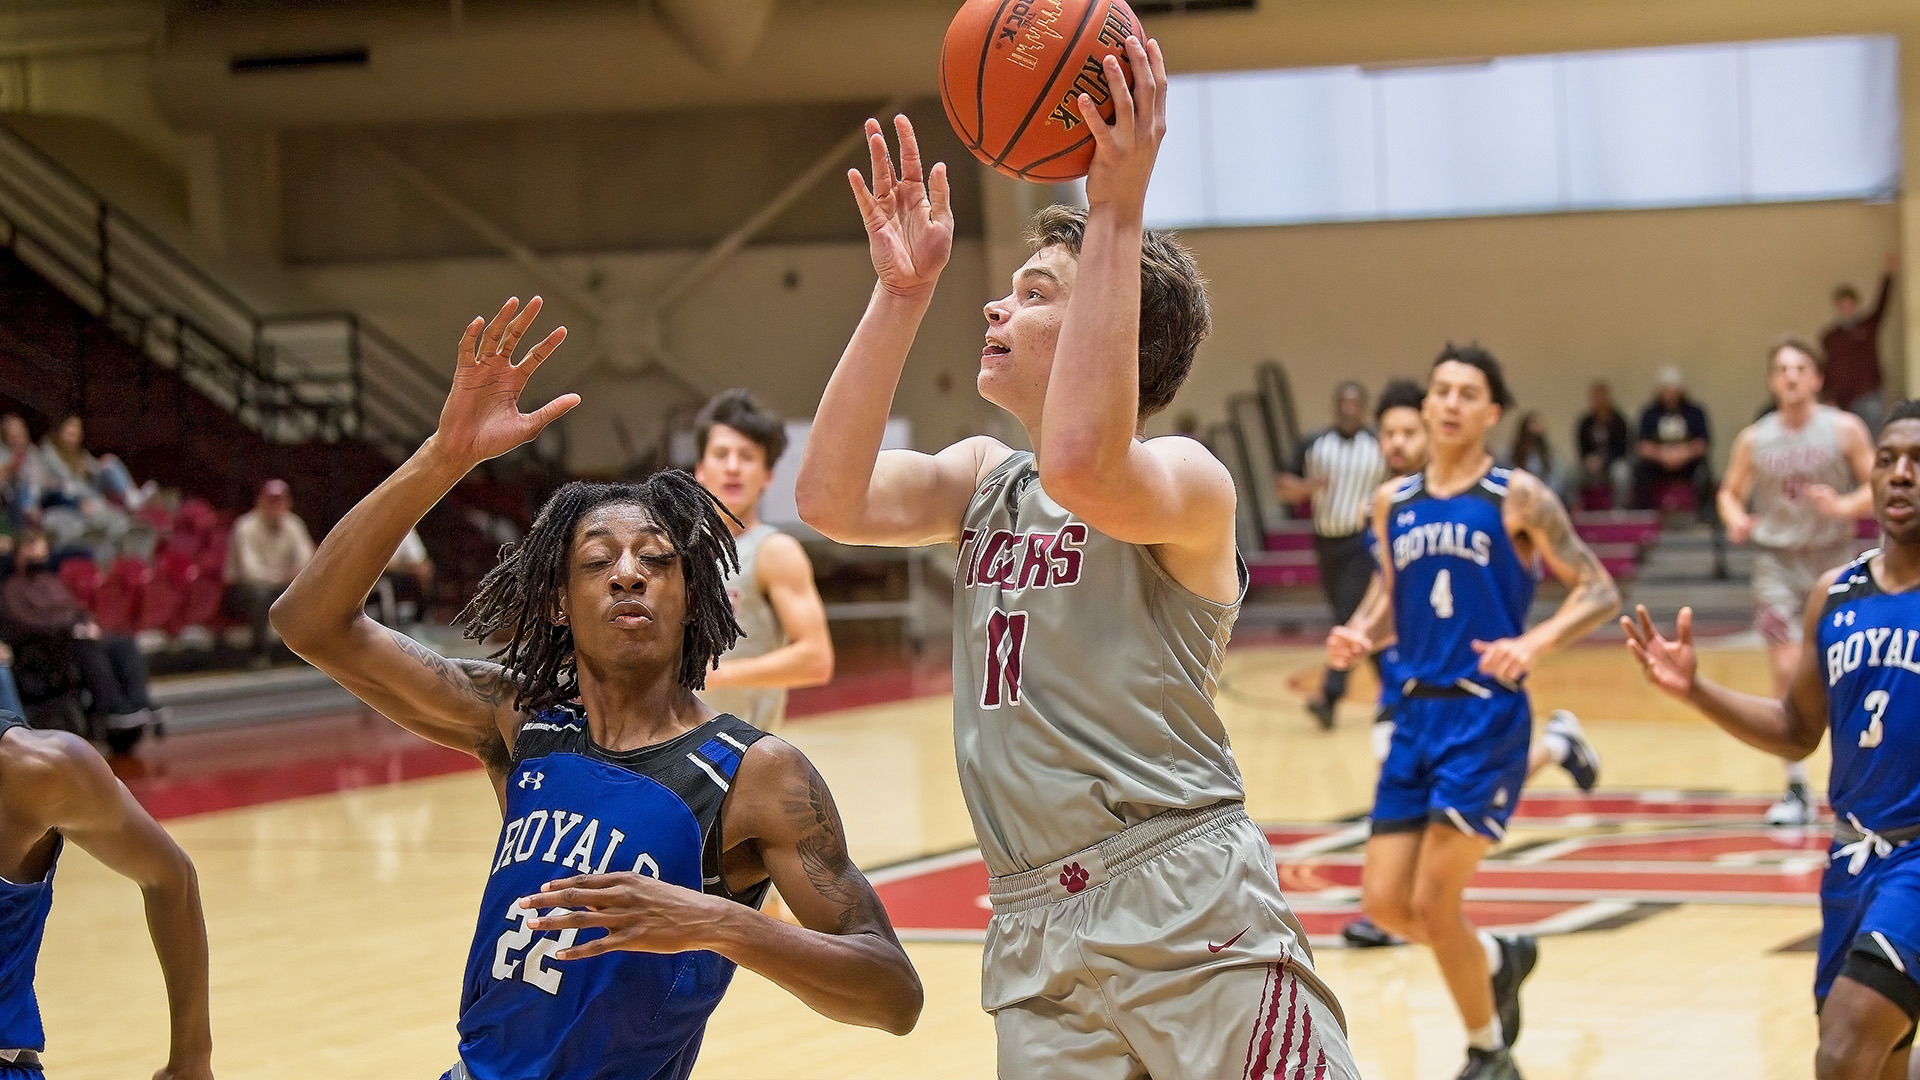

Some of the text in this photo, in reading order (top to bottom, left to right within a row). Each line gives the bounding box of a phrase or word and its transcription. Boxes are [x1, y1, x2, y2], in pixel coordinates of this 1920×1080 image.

[1392, 521, 1492, 572] ROYALS
[1429, 568, 1454, 619] 4
[1858, 689, 1891, 748] 3
[491, 897, 581, 996] 22
